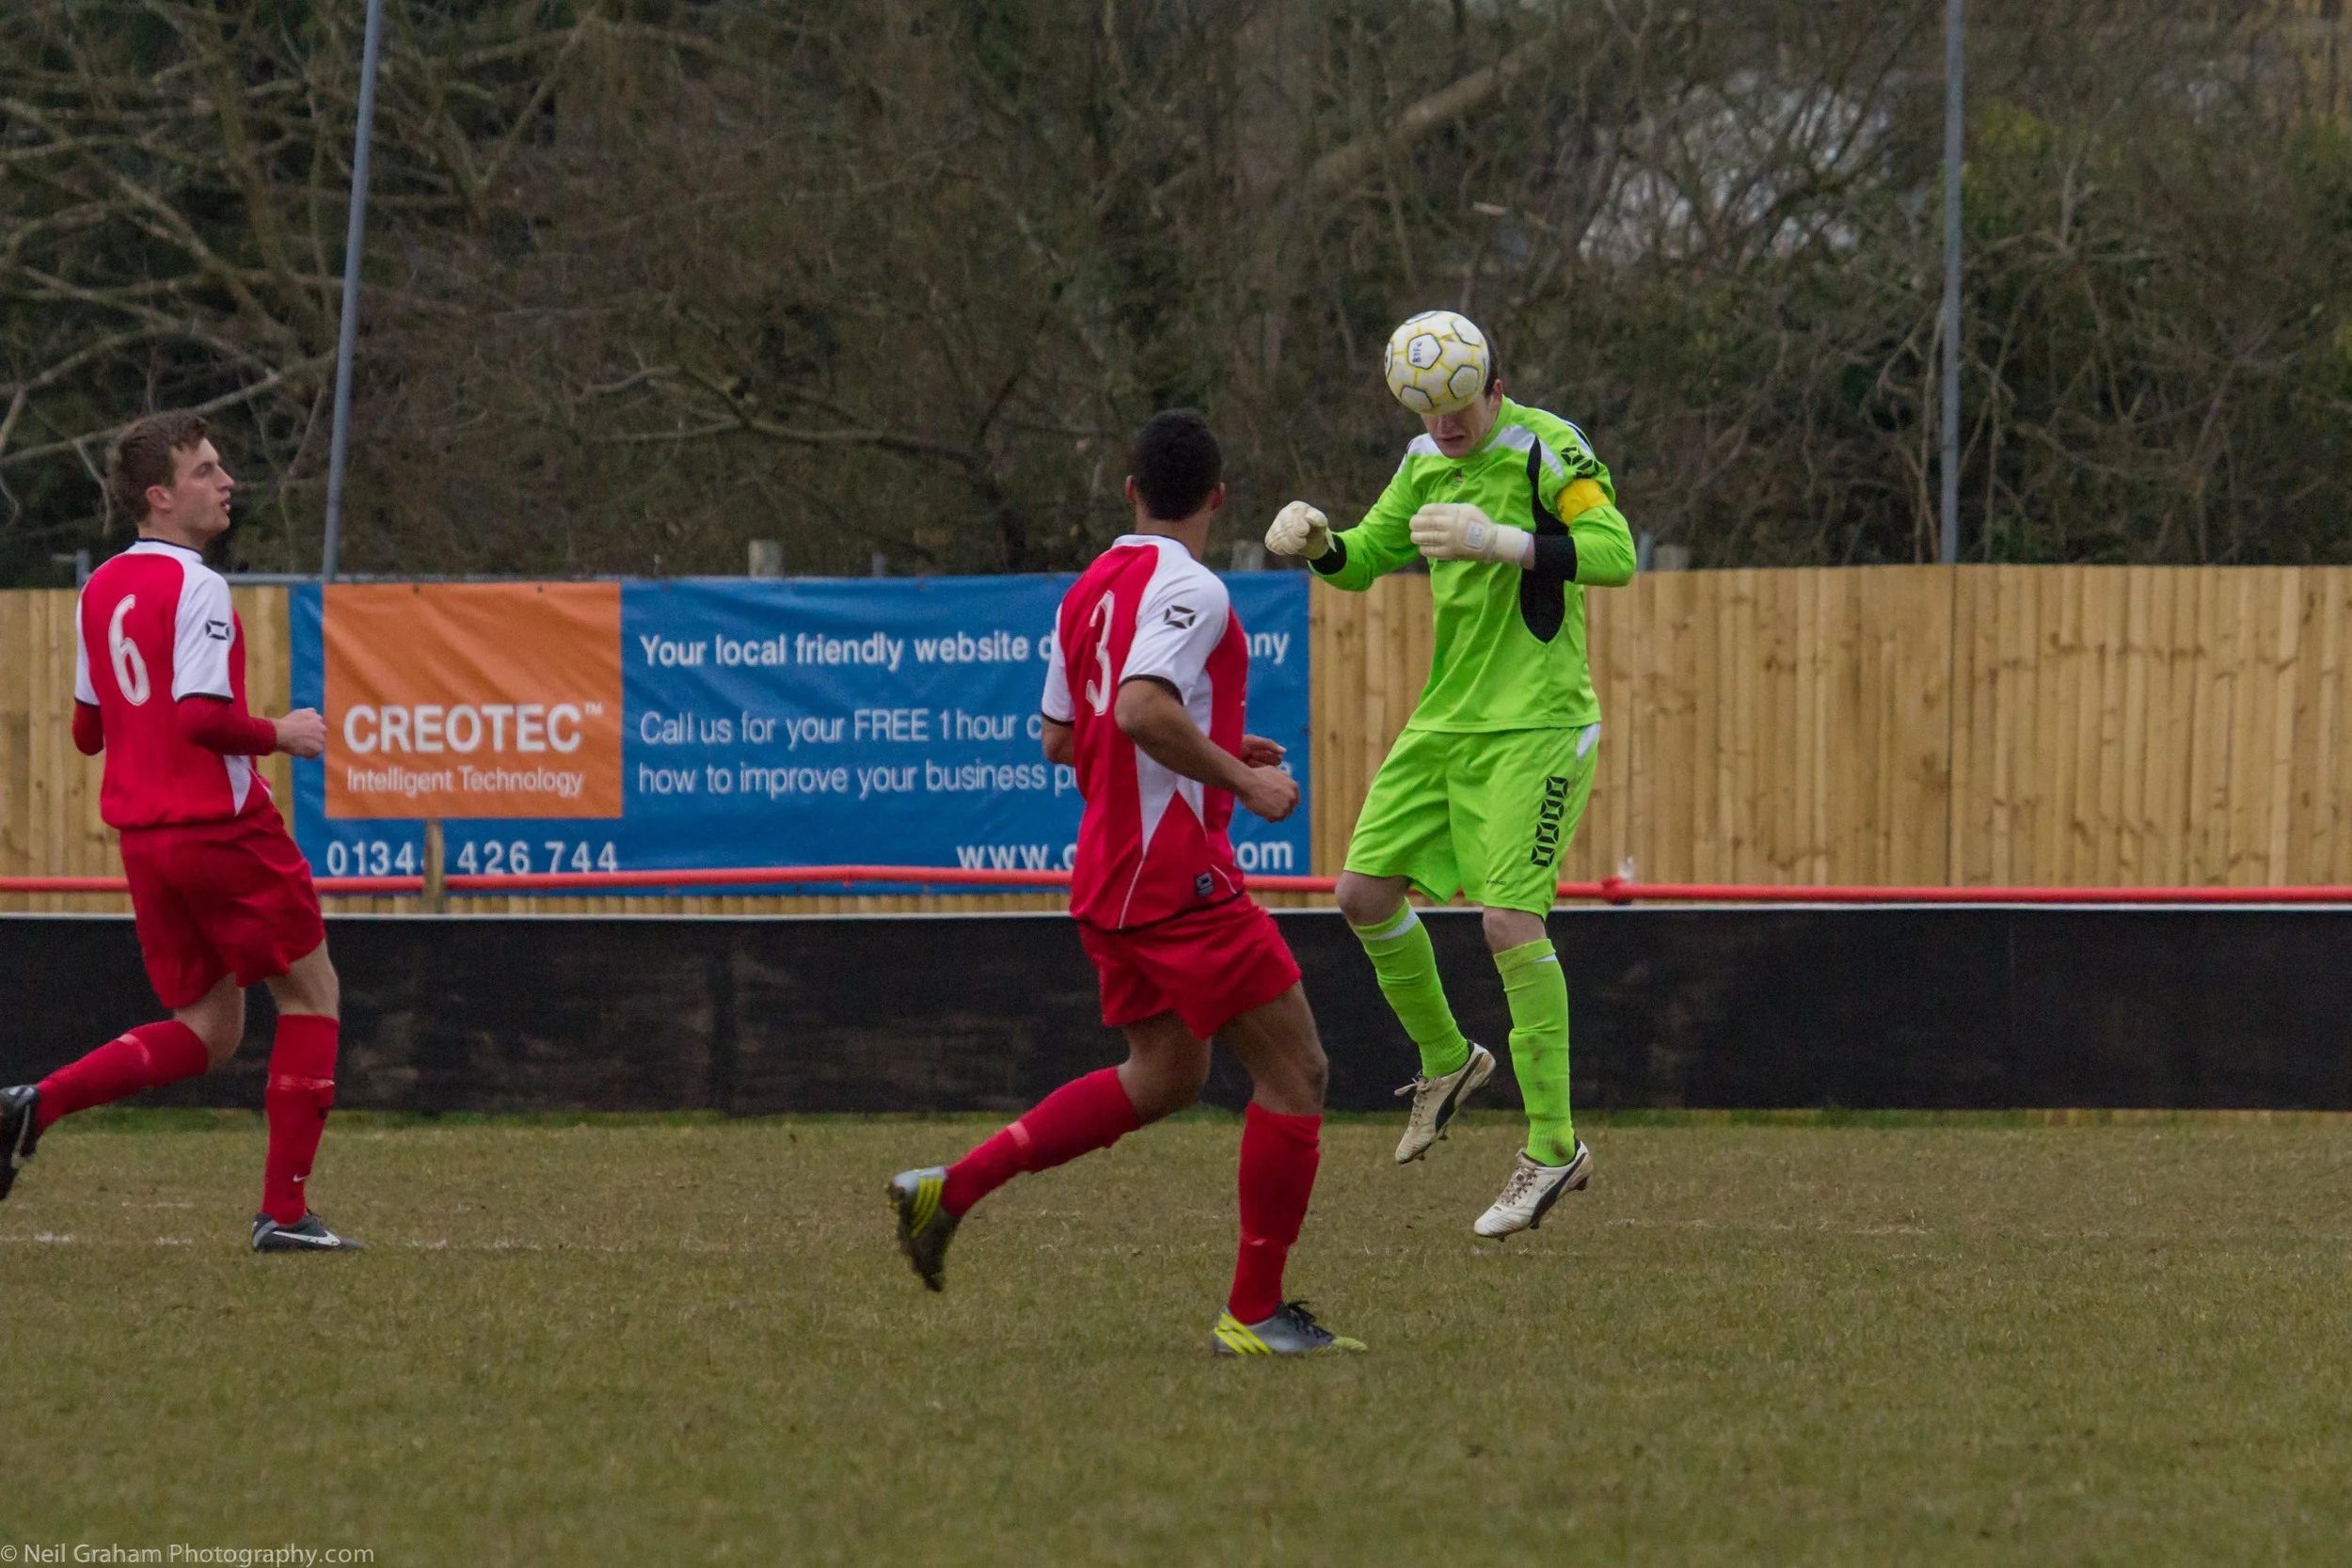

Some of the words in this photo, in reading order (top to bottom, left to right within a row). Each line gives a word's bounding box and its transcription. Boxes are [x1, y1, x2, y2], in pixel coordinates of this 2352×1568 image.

[108, 594, 151, 706] 6
[640, 633, 707, 667] Your
[716, 633, 787, 667] local
[795, 631, 904, 673] friendly
[914, 629, 1030, 663] website
[1086, 590, 1116, 717] 3
[343, 704, 581, 753] CREOTEC
[641, 710, 694, 745] Call
[701, 718, 732, 744] us
[741, 710, 776, 744] for
[787, 717, 845, 752] your
[853, 708, 930, 742] FREE
[347, 766, 453, 798] Intelligent
[457, 763, 583, 798] Technology
[639, 761, 696, 795] how
[707, 763, 733, 795] to
[739, 760, 849, 801] improve
[857, 765, 918, 800] your
[926, 756, 1047, 792] business
[326, 840, 425, 877] 0134
[456, 840, 531, 876] 426
[544, 840, 618, 875] 744
